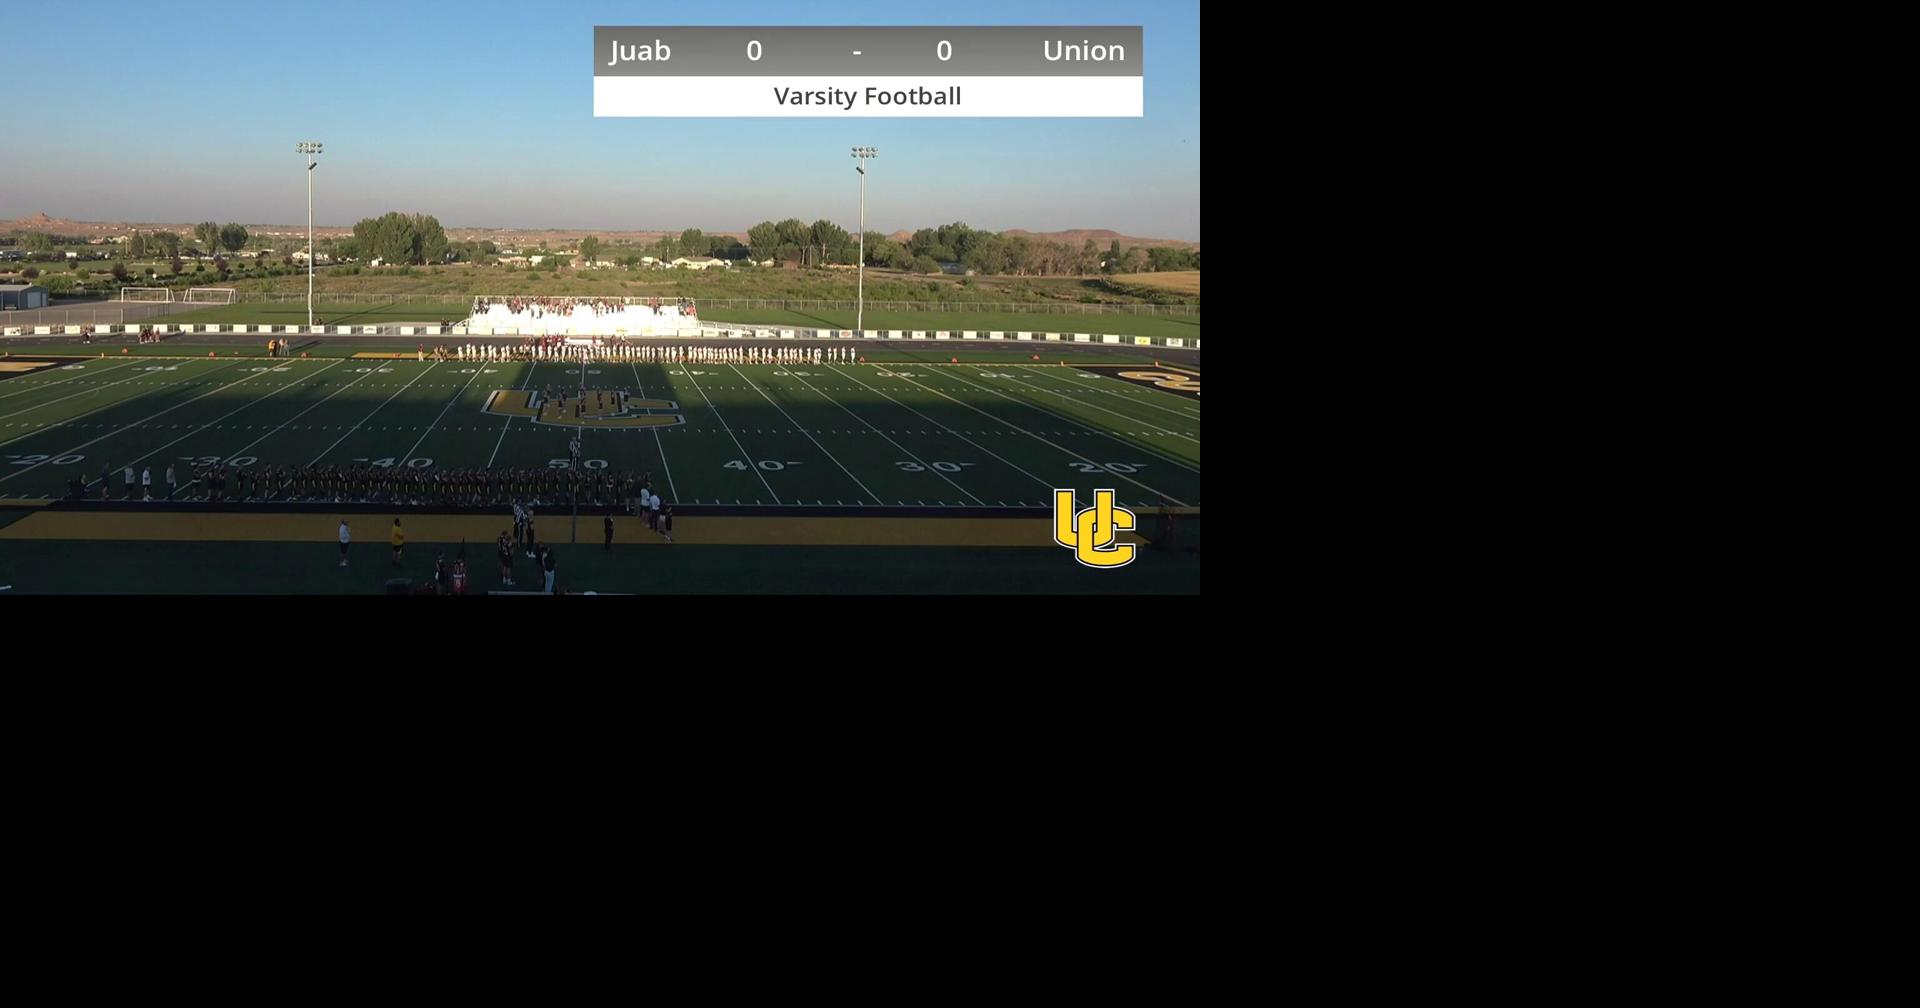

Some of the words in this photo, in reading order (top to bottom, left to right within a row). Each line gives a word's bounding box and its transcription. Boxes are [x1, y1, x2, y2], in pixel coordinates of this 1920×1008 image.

[371, 457, 434, 469] 40
[547, 458, 610, 470] 50
[722, 459, 788, 471] 40
[895, 460, 966, 473] 30
[1068, 462, 1138, 474] 20
